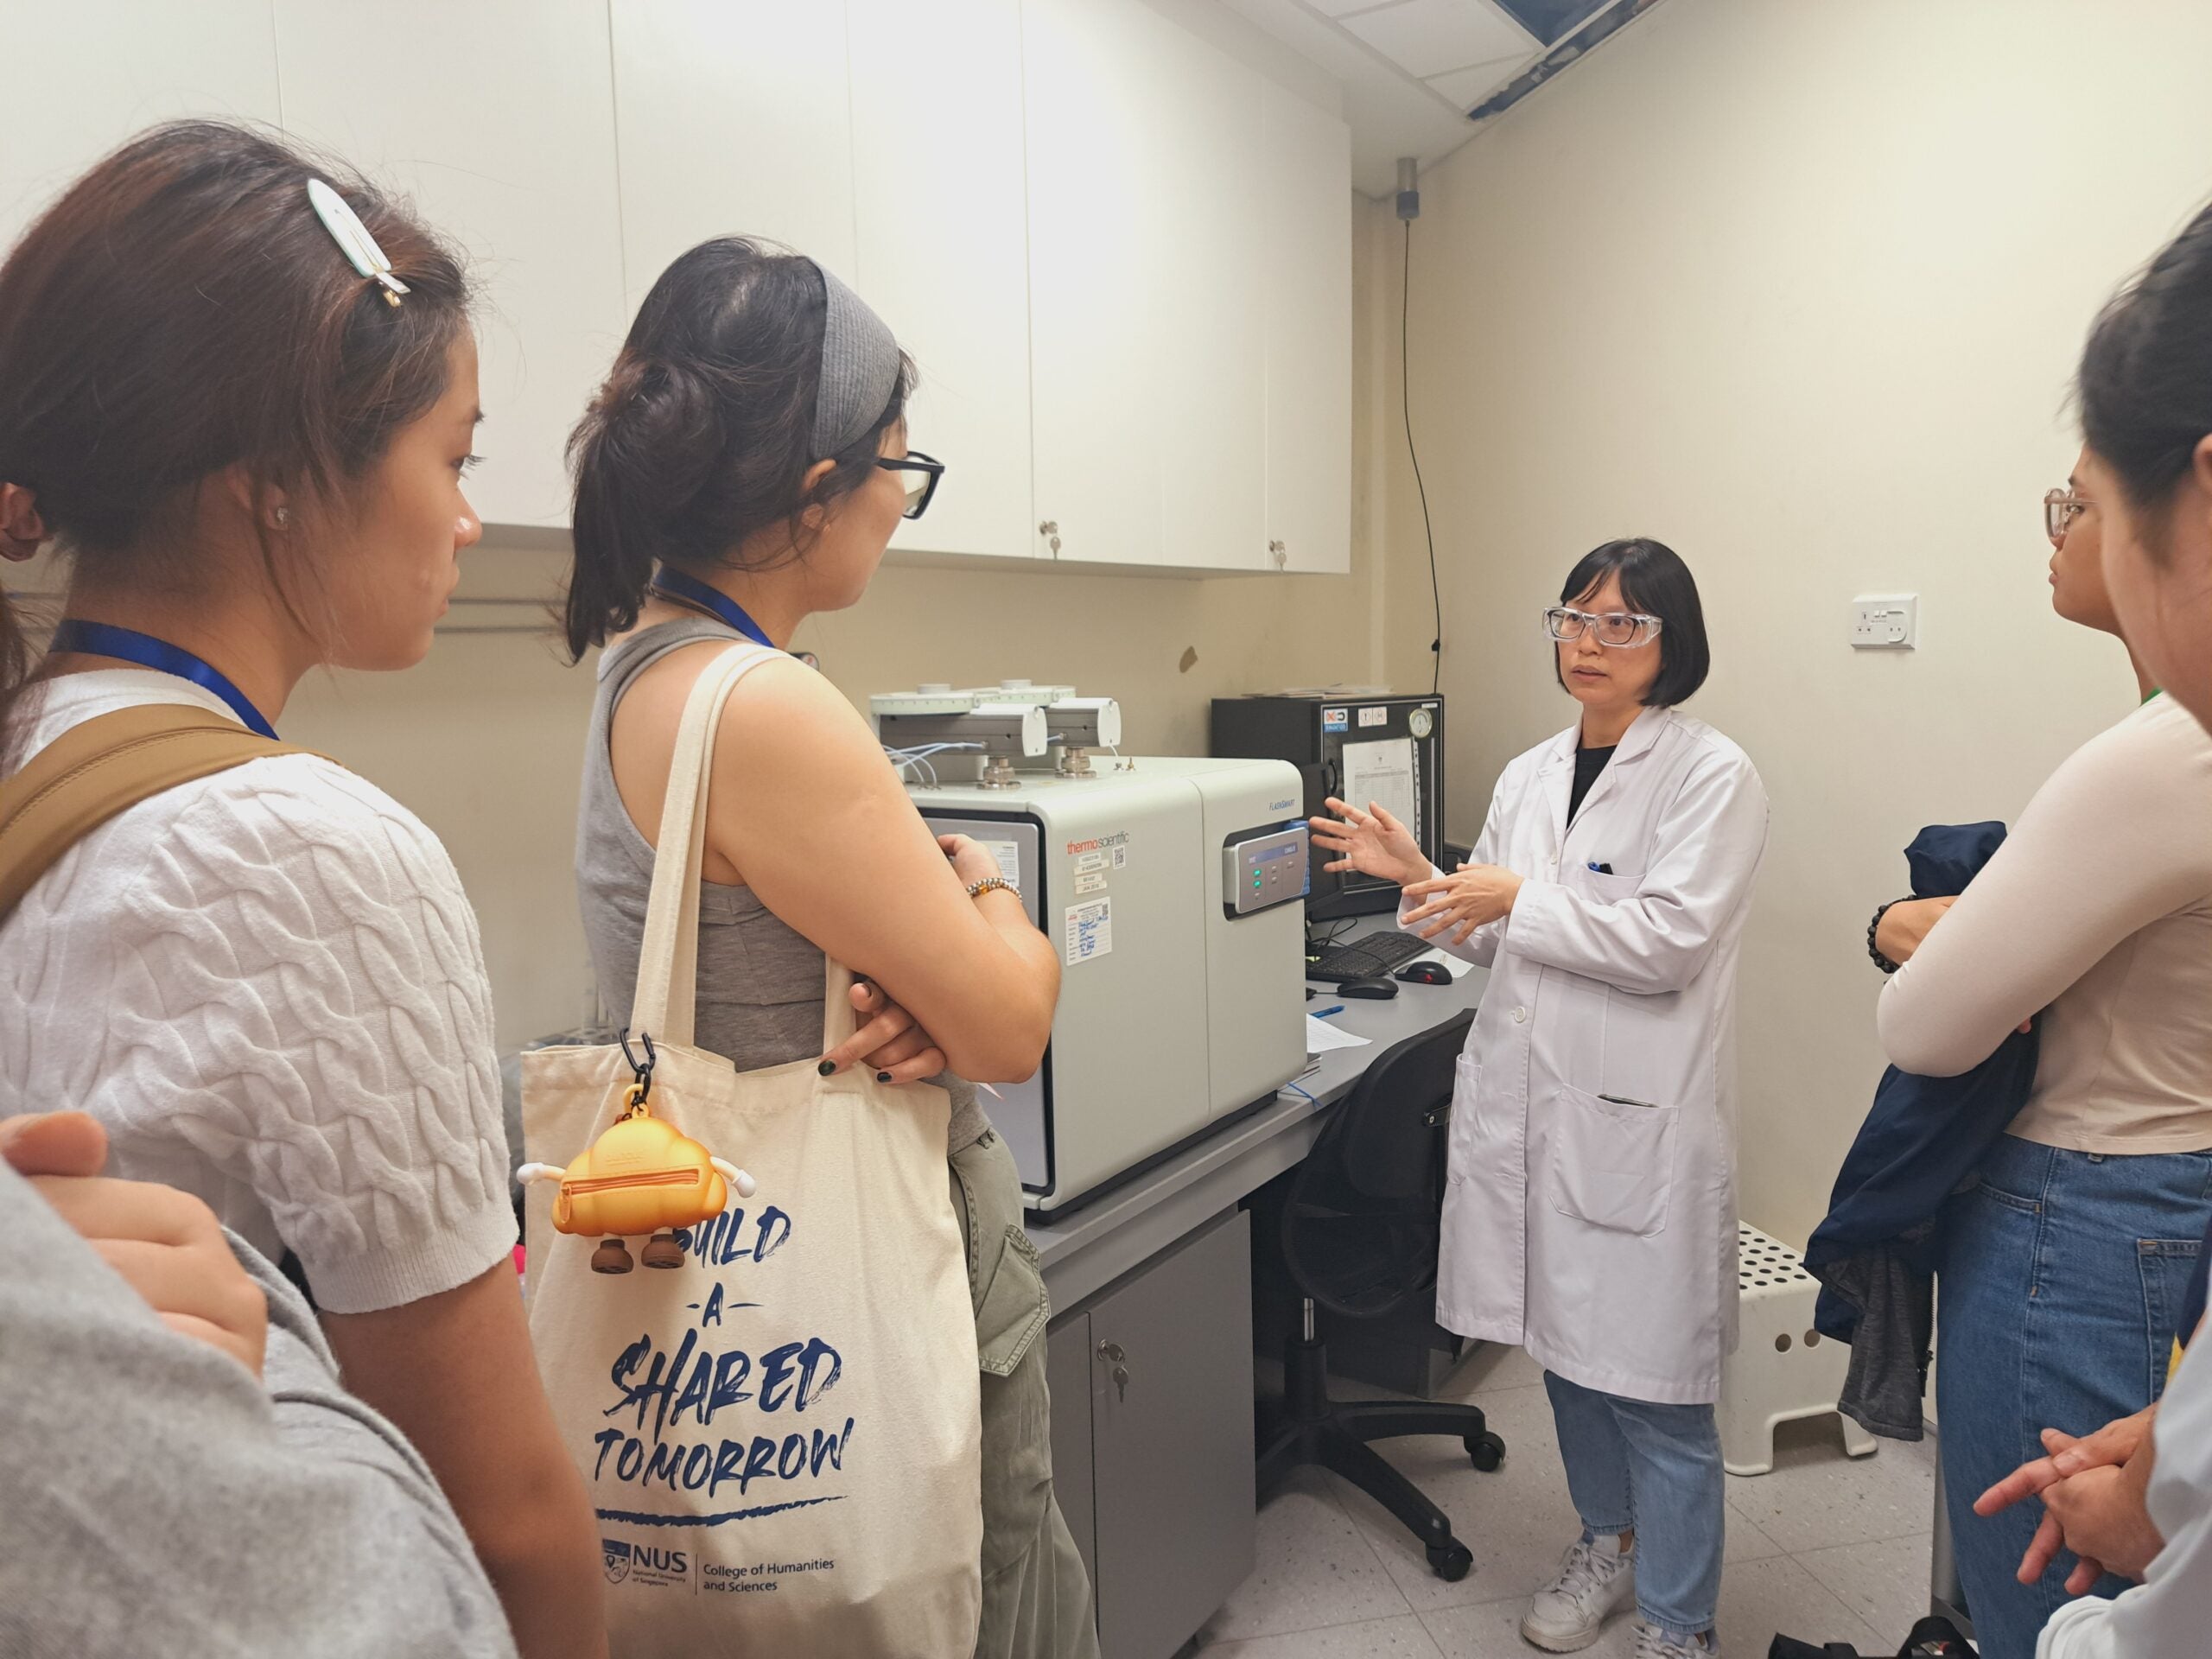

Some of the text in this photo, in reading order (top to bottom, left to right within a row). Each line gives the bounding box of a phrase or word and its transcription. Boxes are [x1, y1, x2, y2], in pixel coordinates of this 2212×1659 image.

[1067, 831, 1129, 855] thermo scientific
[602, 1327, 842, 1445] SHARED
[594, 1416, 855, 1498] TOMORROW
[633, 1544, 687, 1573] NUS
[703, 1558, 835, 1580] College of Humanities
[703, 1580, 778, 1592] and Sciences
